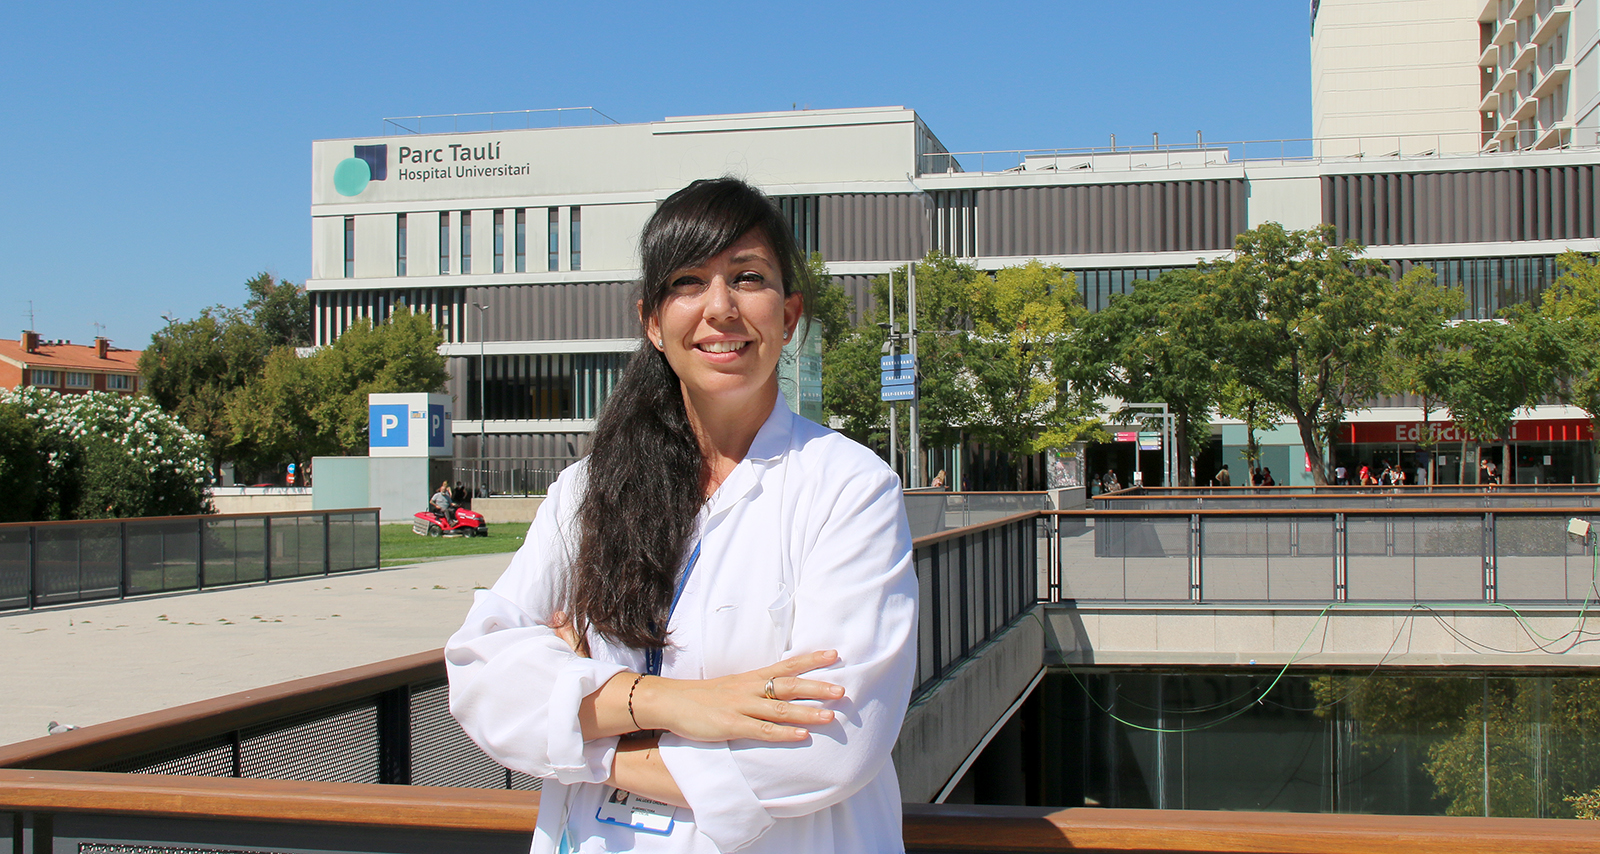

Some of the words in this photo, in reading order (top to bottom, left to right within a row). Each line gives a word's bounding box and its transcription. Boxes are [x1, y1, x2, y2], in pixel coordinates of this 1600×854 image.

[398, 146, 443, 164] Parc
[448, 141, 501, 161] Taulí
[398, 166, 452, 183] Hospital
[455, 163, 530, 178] Universitari
[381, 414, 399, 437] P
[432, 414, 440, 437] P
[1395, 422, 1460, 441] Edfici
